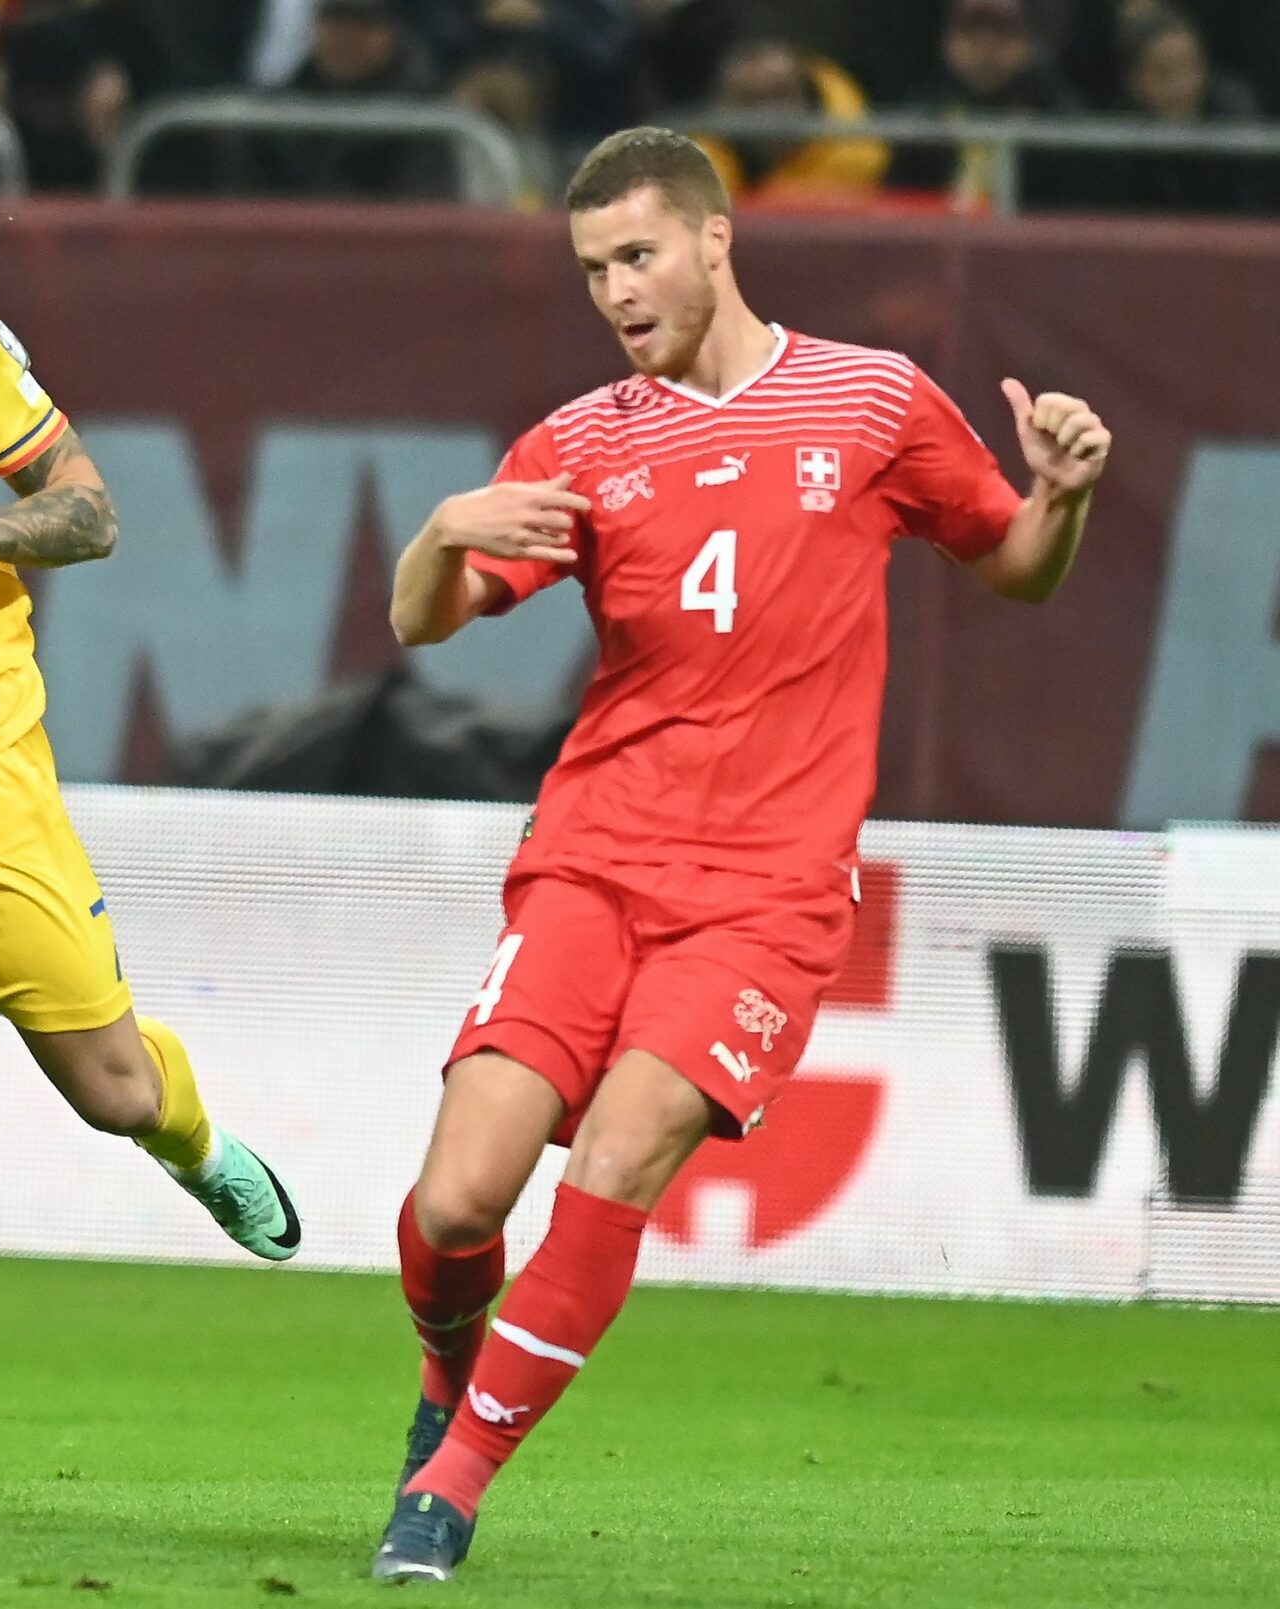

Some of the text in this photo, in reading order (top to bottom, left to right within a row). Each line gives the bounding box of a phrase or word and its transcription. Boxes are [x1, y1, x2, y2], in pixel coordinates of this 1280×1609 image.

[680, 530, 738, 633] 4
[472, 934, 524, 1025] 4
[987, 942, 1280, 1212] W
